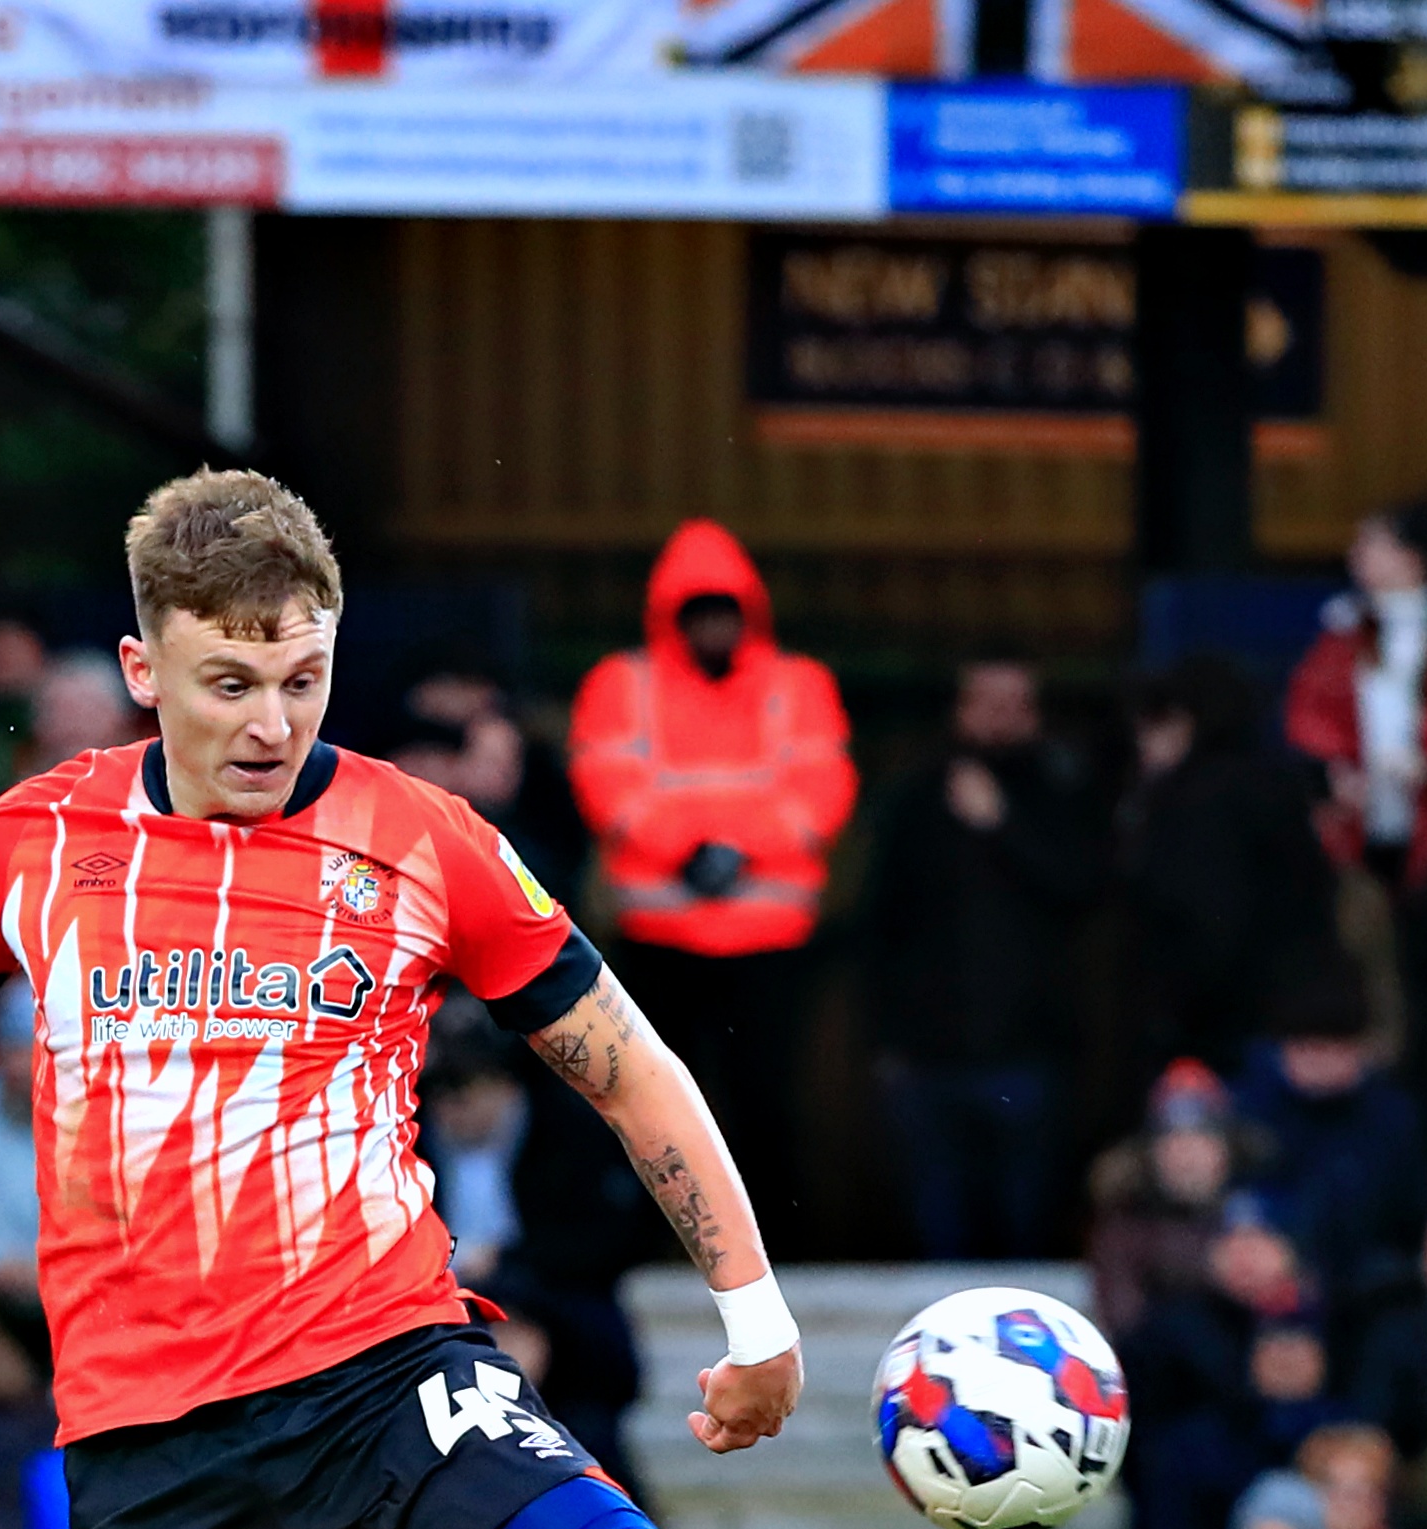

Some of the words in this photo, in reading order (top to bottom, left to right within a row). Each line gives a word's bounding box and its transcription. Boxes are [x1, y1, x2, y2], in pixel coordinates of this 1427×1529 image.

[92, 951, 297, 1009] utilita
[92, 1015, 129, 1042] life
[140, 1013, 196, 1038] with
[205, 1019, 296, 1042] power
[418, 1360, 560, 1456] 45
